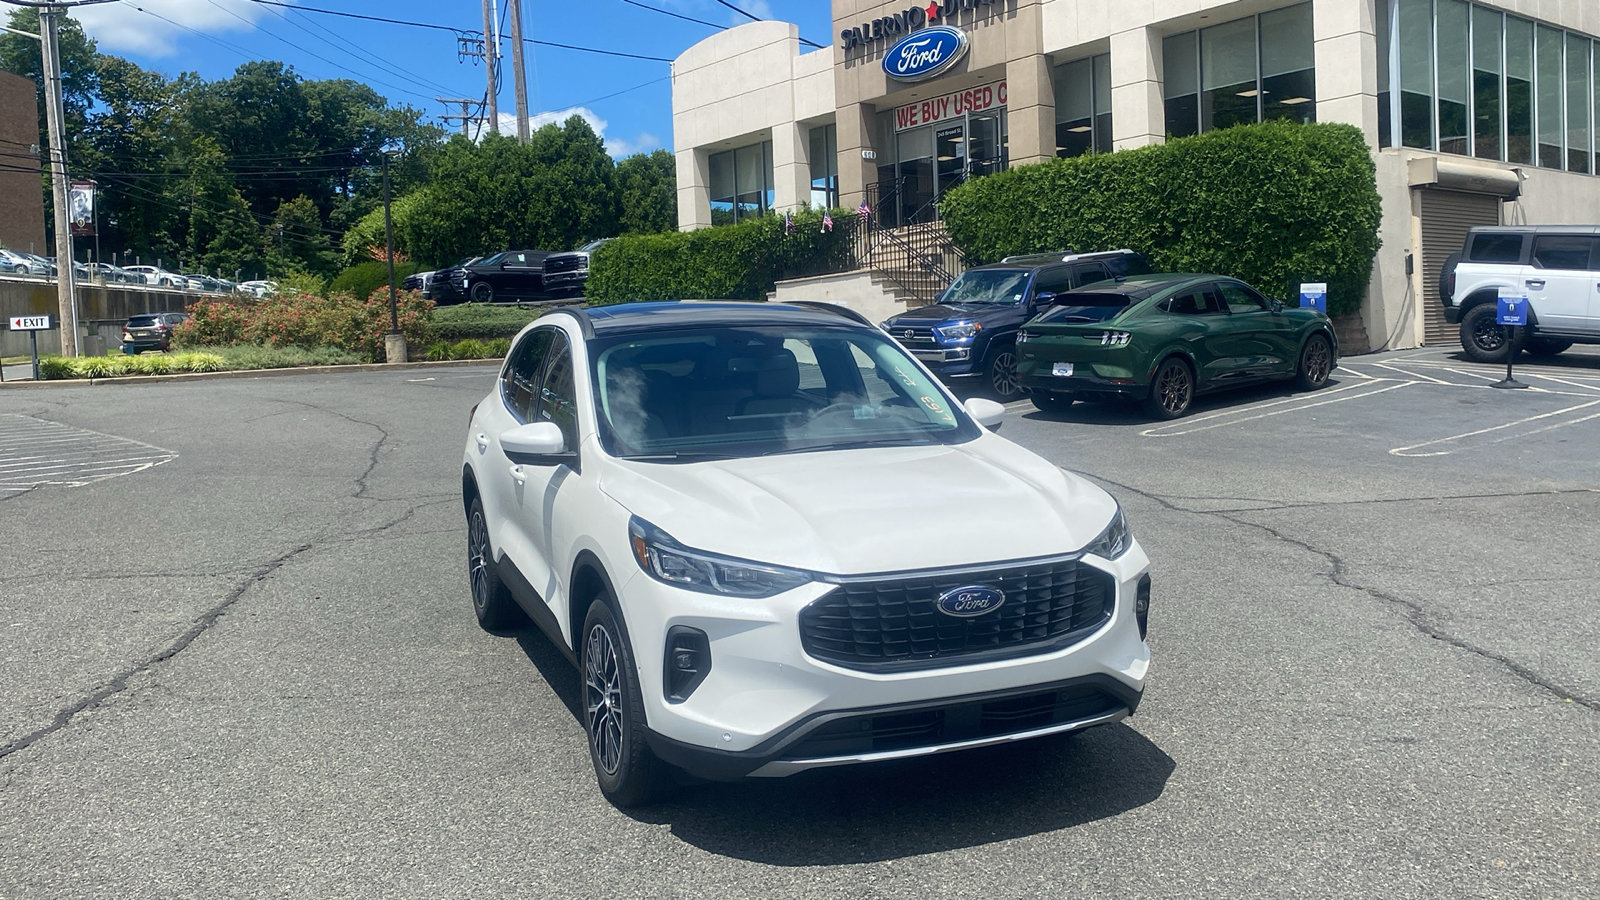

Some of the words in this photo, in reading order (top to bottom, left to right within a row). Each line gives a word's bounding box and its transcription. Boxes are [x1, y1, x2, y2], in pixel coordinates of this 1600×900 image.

[841, 6, 926, 50] SALERNO
[897, 38, 943, 72] Ford
[896, 105, 918, 128] WE
[922, 96, 950, 123] BUY
[954, 86, 993, 115] USED
[23, 317, 45, 327] EXIT
[955, 592, 990, 611] Ford
